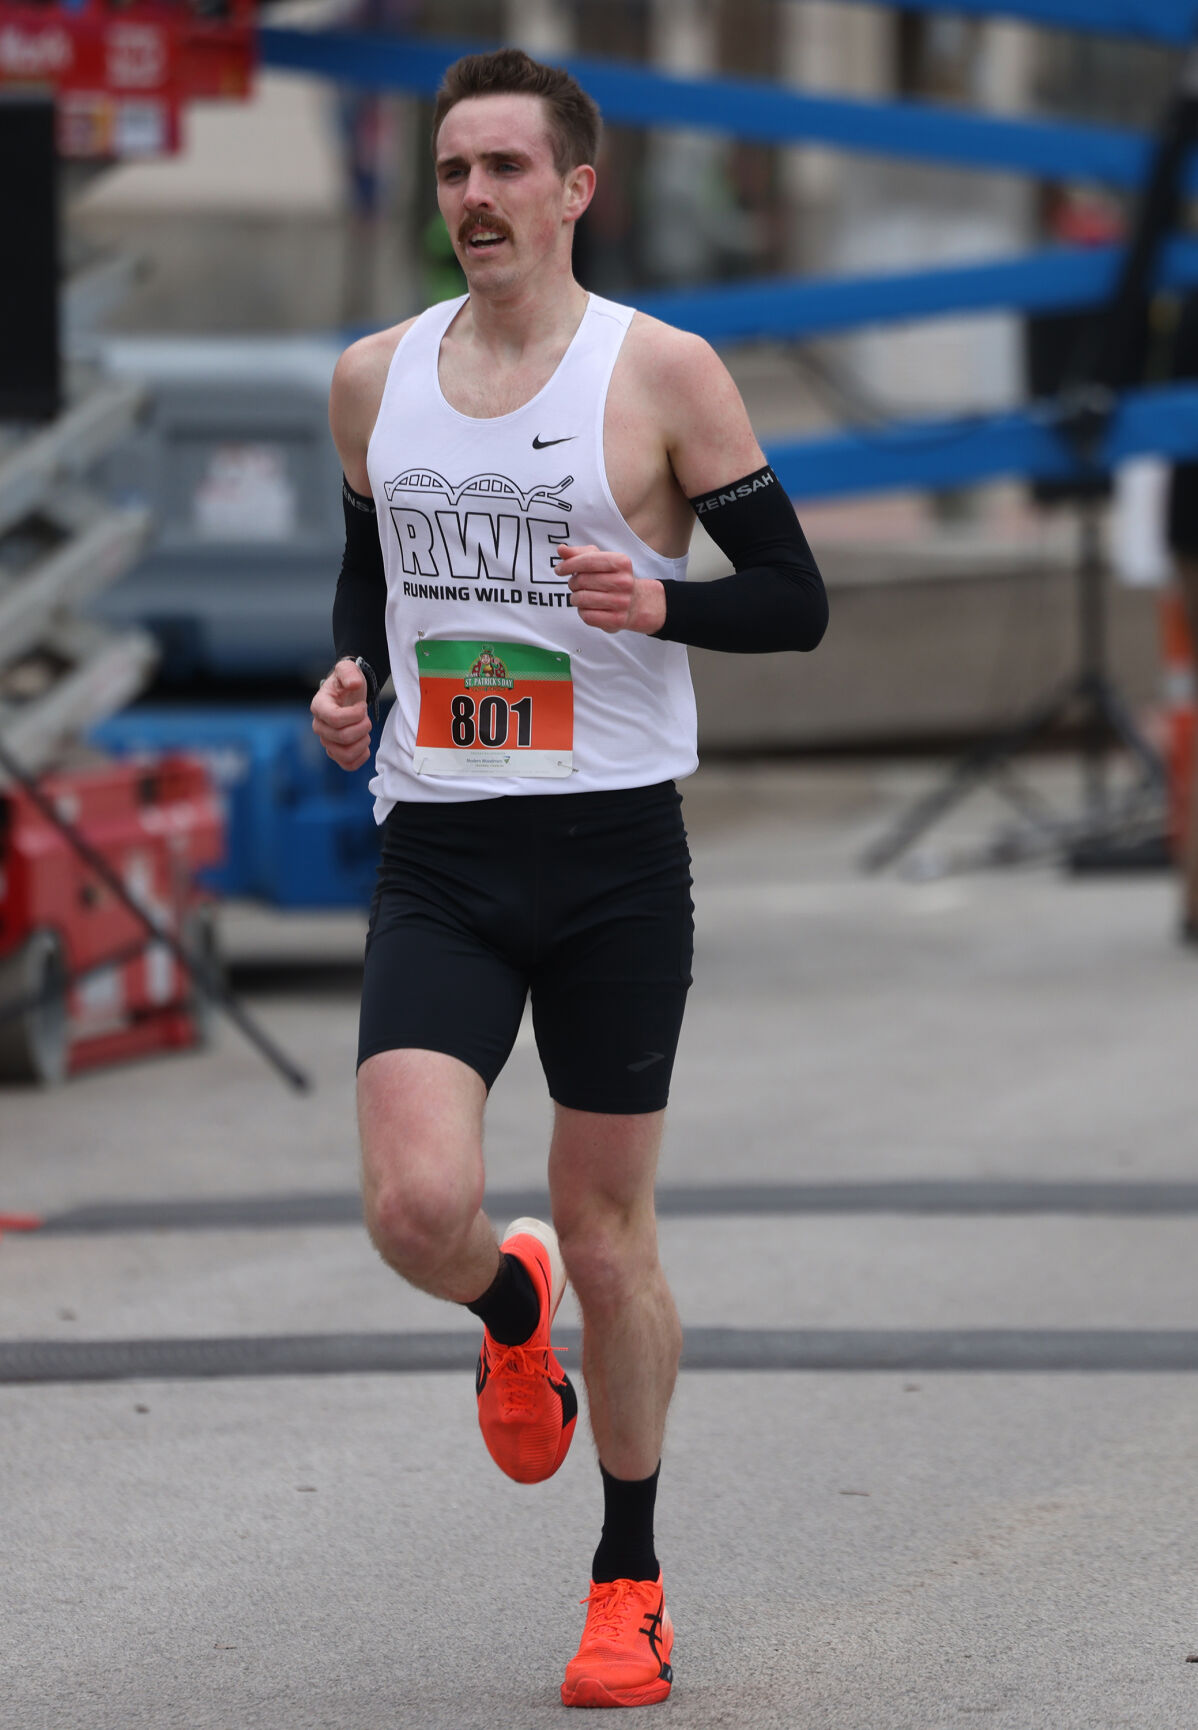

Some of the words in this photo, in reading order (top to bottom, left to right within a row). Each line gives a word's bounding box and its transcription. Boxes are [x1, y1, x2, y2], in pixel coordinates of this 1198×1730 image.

[695, 472, 774, 514] ZENSAH
[389, 507, 570, 585] RWE
[403, 581, 470, 601] RUNNING
[474, 587, 523, 604] WILD
[474, 677, 501, 687] PATRICK'S
[501, 678, 513, 688] DAY
[451, 694, 533, 748] 801
